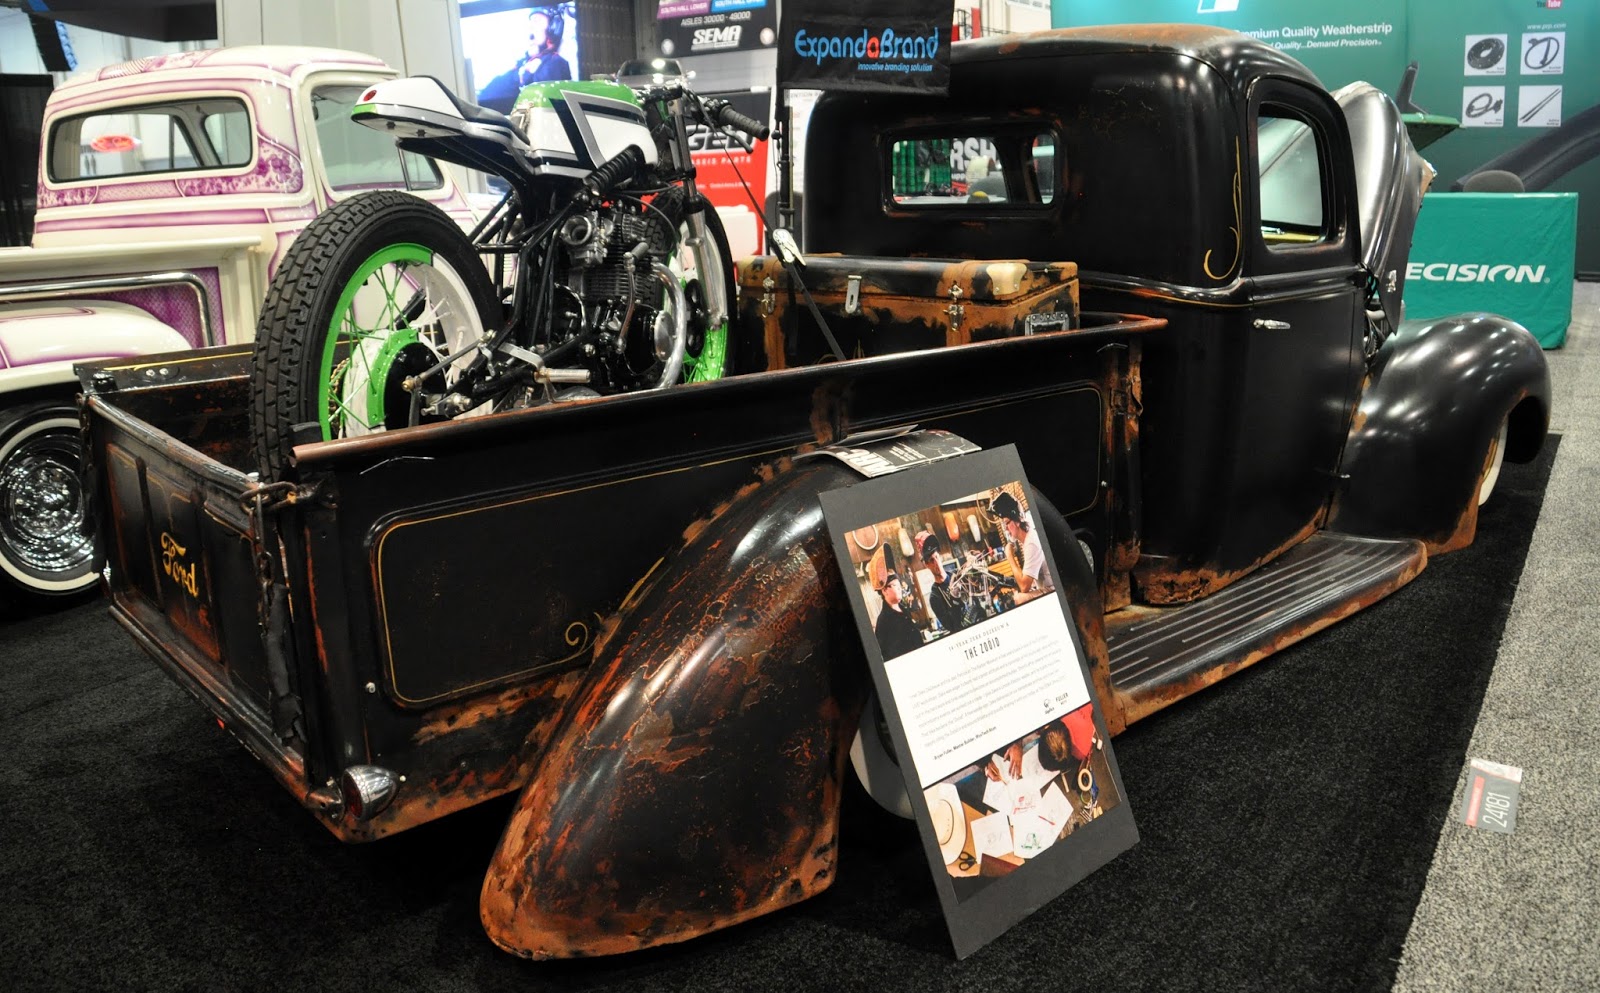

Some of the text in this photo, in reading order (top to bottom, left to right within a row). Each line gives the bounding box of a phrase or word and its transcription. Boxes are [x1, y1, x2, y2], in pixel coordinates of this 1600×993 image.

[681, 16, 702, 26] AISLES
[704, 14, 724, 24] 30000
[729, 11, 751, 20] 49000
[692, 25, 742, 45] SEMA
[1281, 26, 1319, 38] Quality
[1321, 22, 1393, 35] Weatherstrip
[857, 62, 884, 71] innovative
[884, 62, 910, 74] branding
[161, 532, 199, 597] Ford
[964, 646, 978, 660] THE
